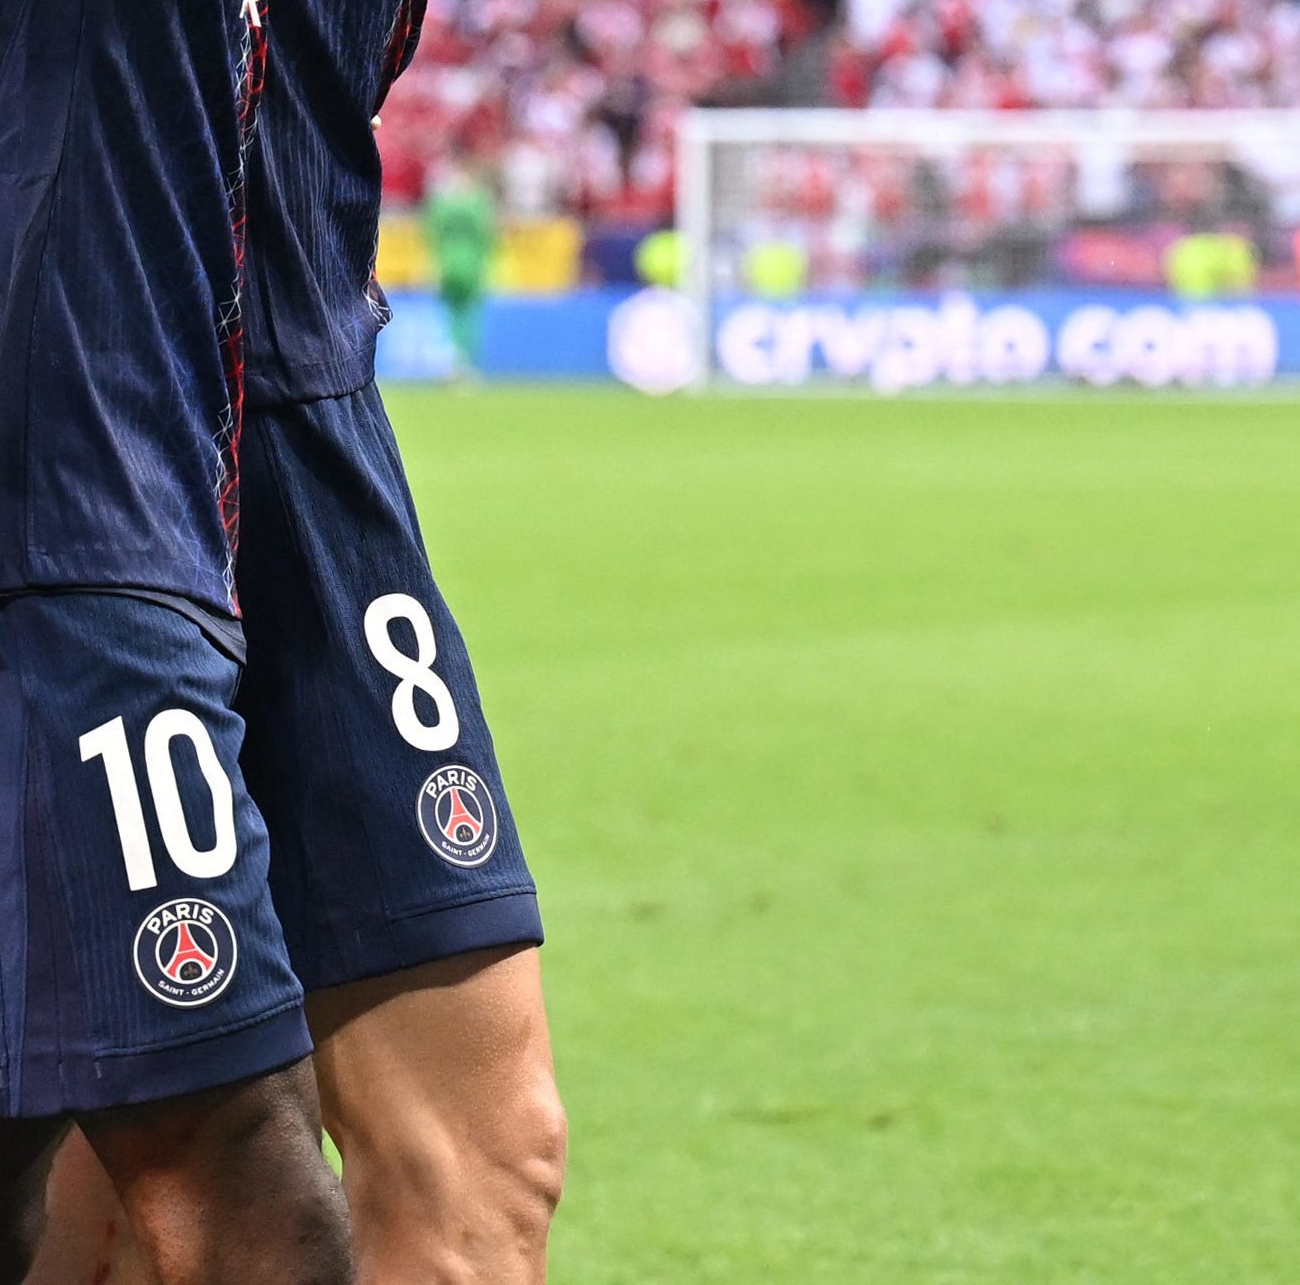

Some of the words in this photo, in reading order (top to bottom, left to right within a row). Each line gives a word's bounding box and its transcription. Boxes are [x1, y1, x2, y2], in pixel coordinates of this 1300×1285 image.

[364, 592, 460, 751] 8
[79, 708, 237, 892] 10
[426, 770, 478, 799] PARIS
[146, 903, 214, 935] PARIS
[158, 980, 184, 996] SAINT
[191, 968, 225, 996] GERMAIN
